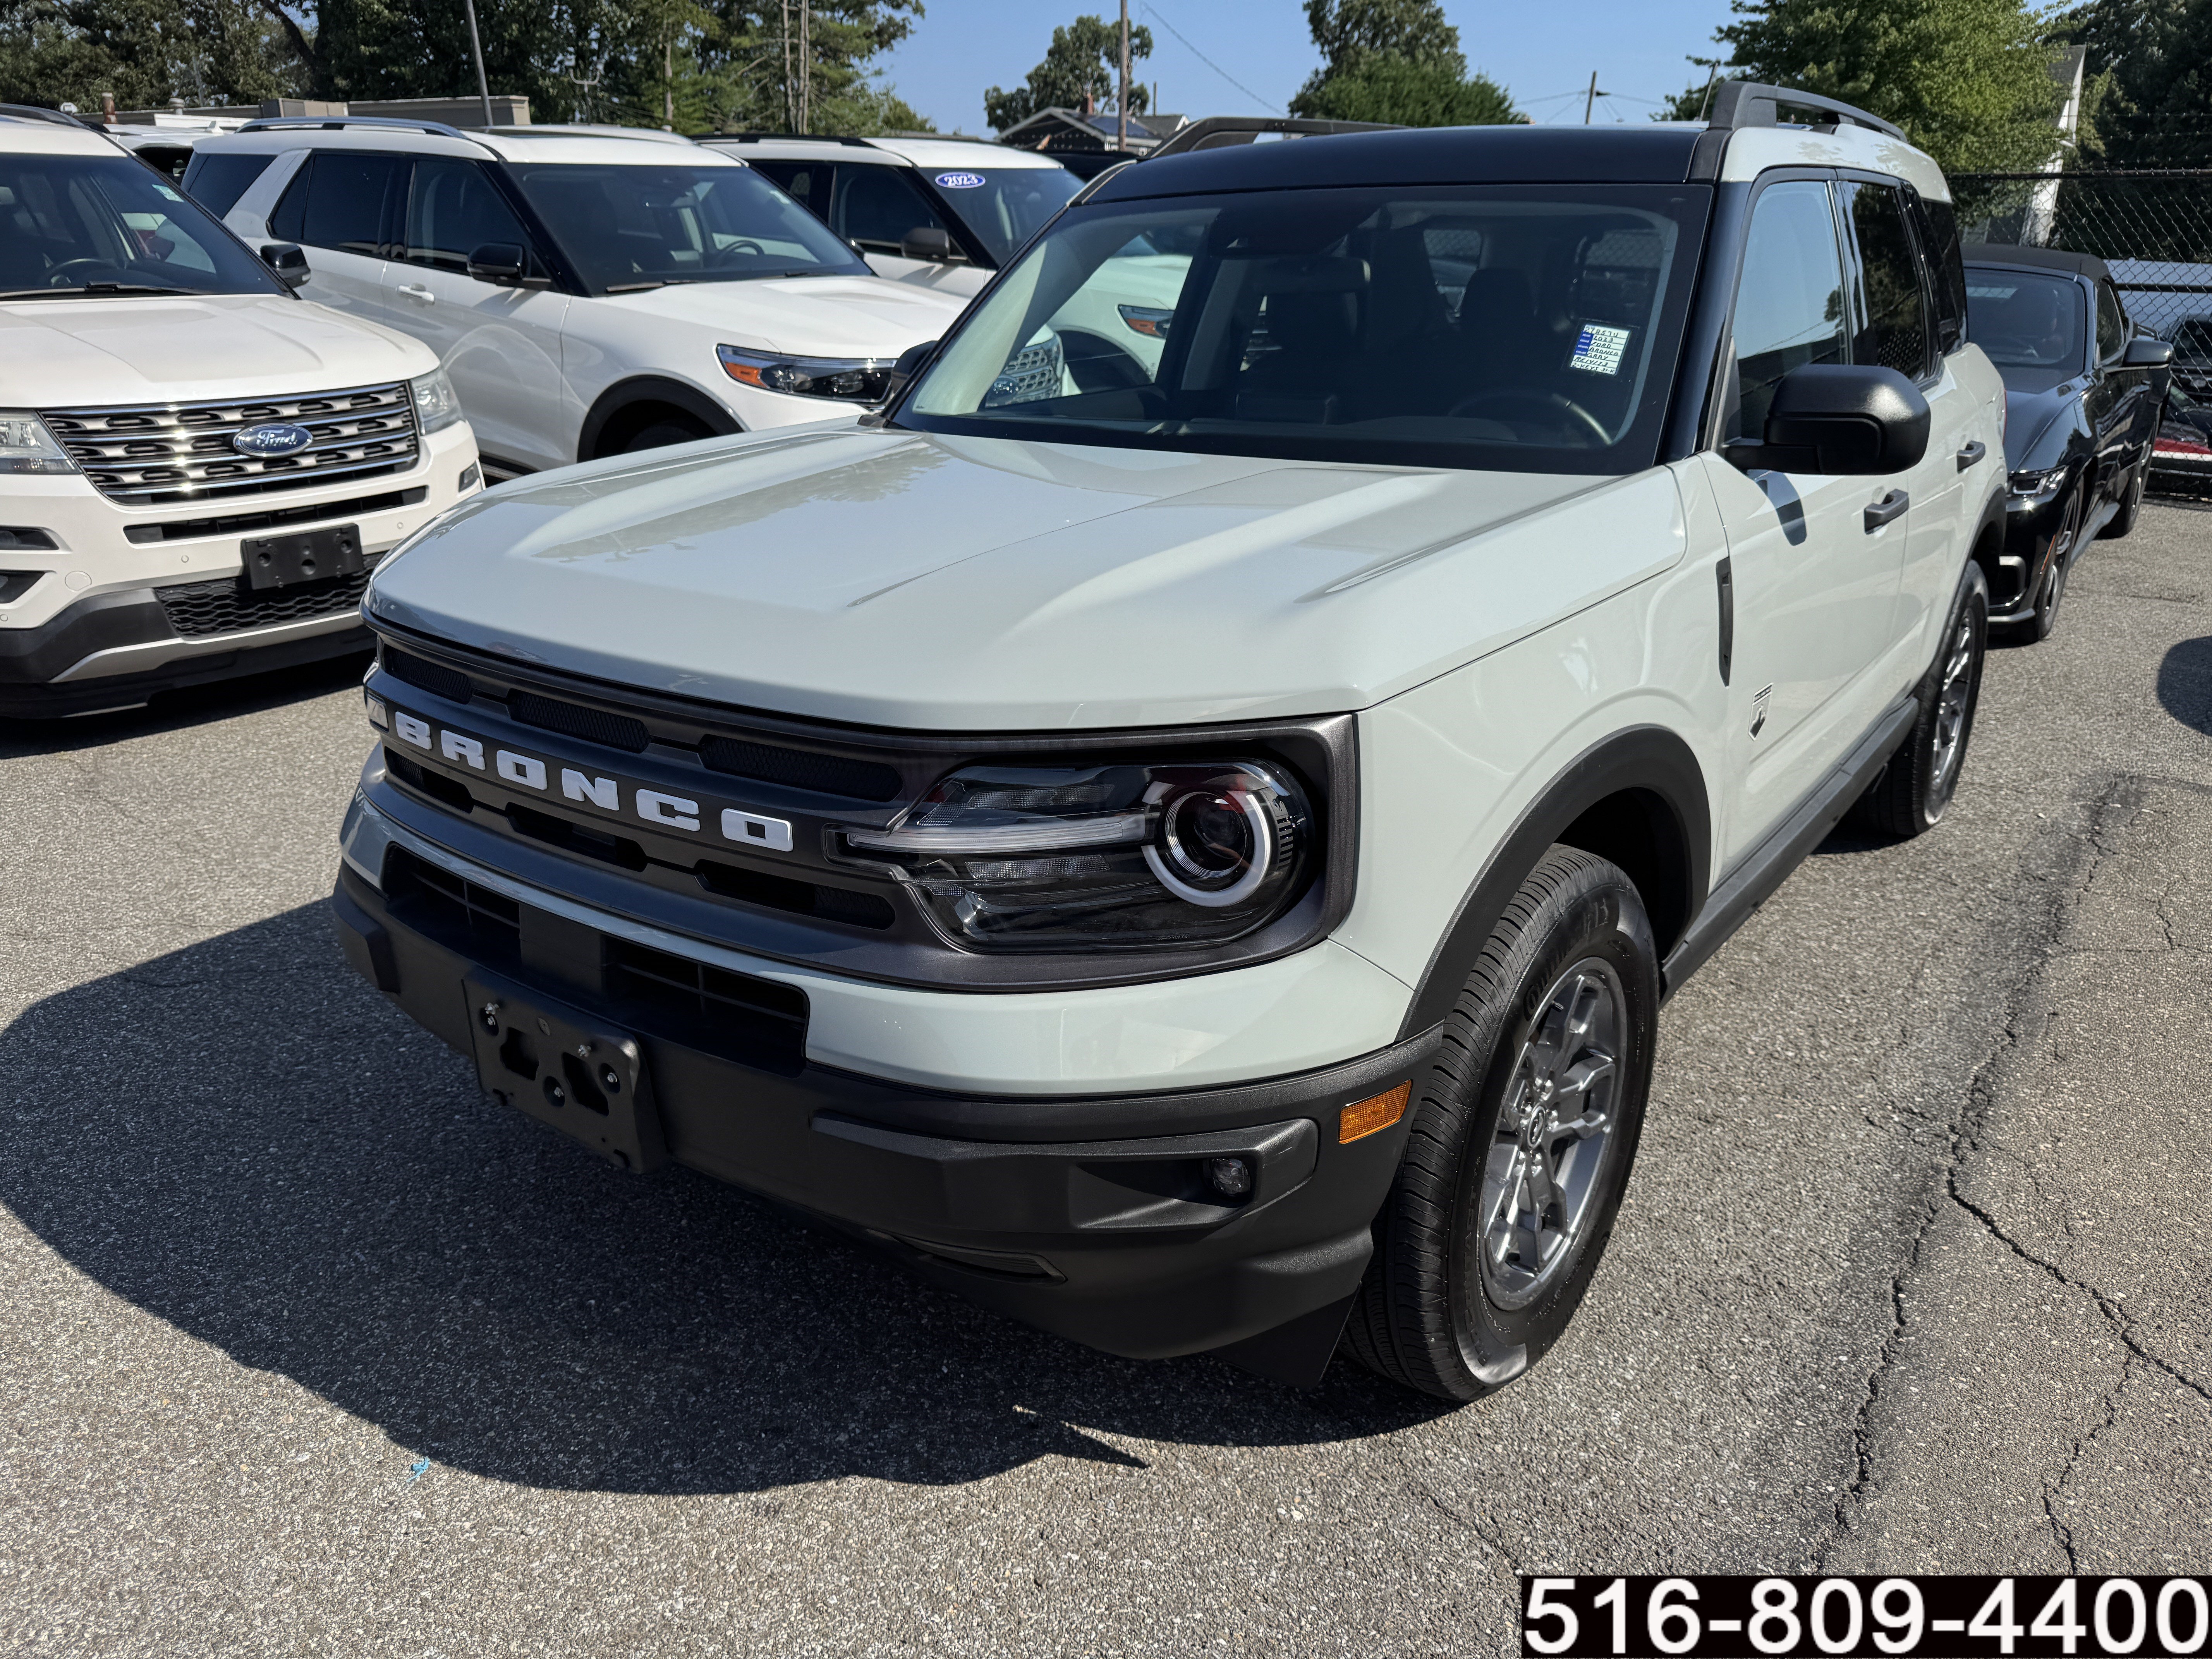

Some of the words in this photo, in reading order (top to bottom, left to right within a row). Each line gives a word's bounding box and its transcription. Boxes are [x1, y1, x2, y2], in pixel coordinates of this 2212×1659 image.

[944, 174, 978, 186] 2023
[256, 428, 298, 447] Ford
[395, 711, 794, 852] BRONCO
